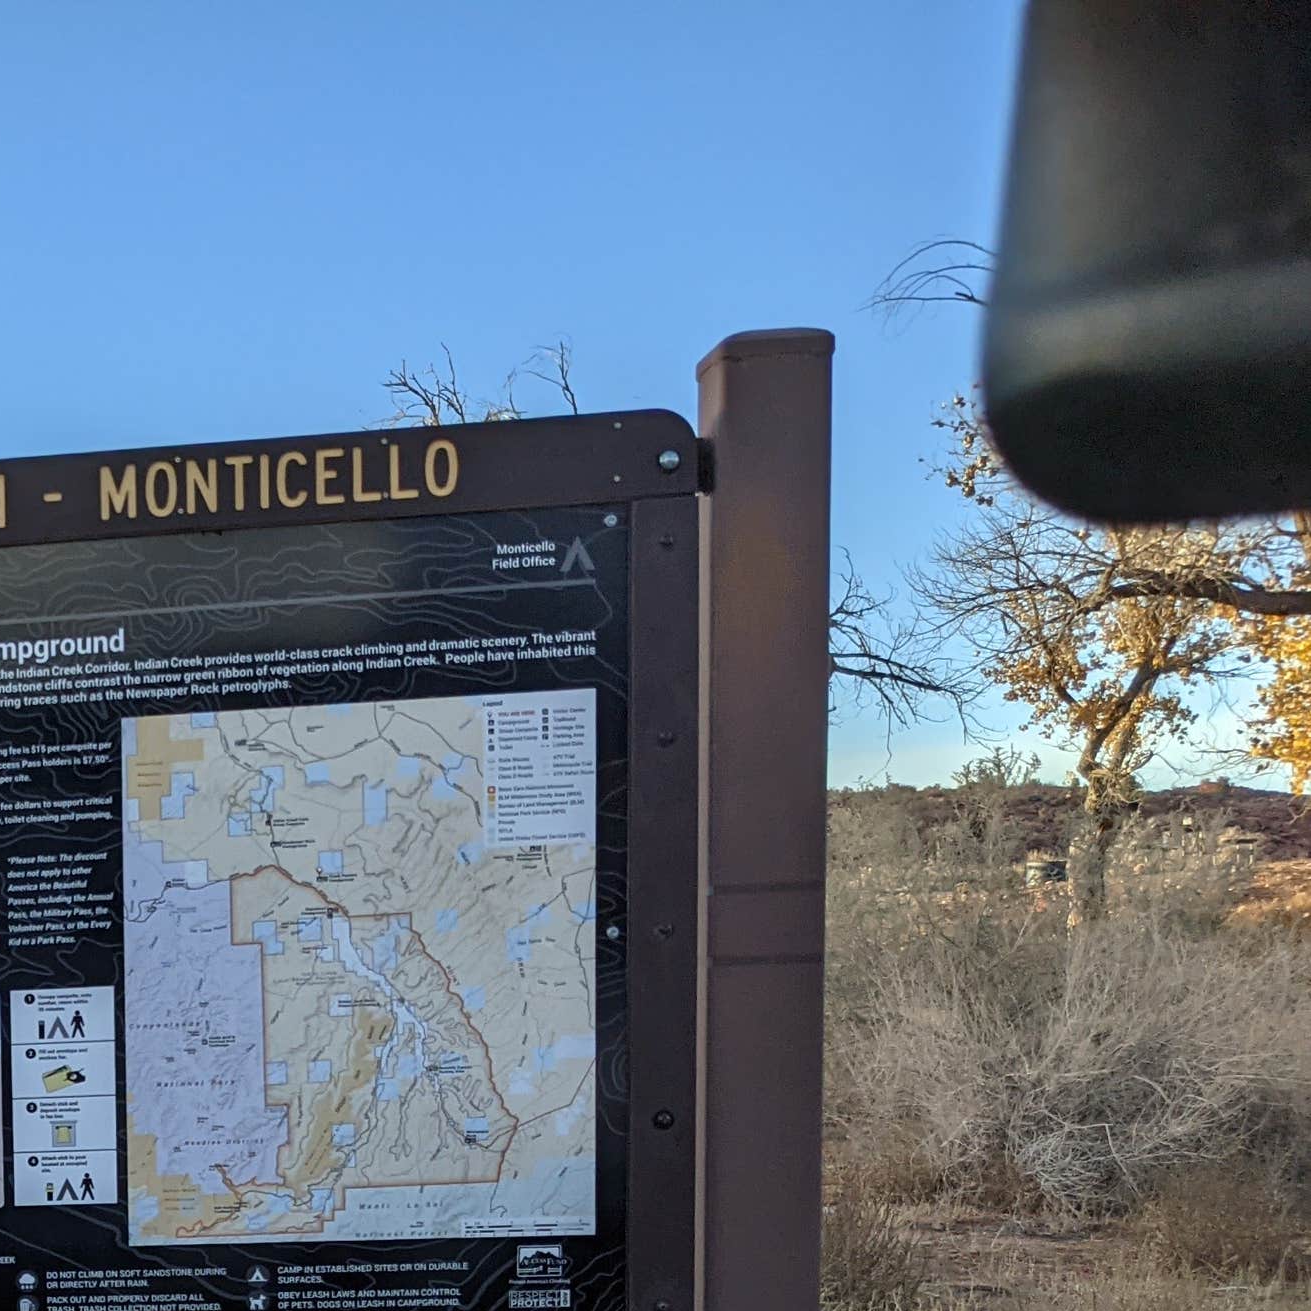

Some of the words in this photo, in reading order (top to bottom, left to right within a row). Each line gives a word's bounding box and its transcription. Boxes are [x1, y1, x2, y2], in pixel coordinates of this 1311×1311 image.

[100, 440, 460, 518] MONTICELLO
[496, 541, 555, 554] Monticello
[492, 558, 519, 570] Field
[522, 556, 555, 568] Office
[15, 666, 49, 679] Indian
[51, 663, 83, 677] Creek
[84, 661, 132, 674] Corridor.
[134, 659, 169, 671] Indian
[170, 656, 202, 669] Creek
[204, 653, 252, 670] provides
[254, 649, 319, 664] world-class
[321, 646, 352, 659] crack
[354, 644, 403, 657] climbing
[405, 641, 427, 654] and
[428, 638, 479, 652] dramatic
[481, 637, 529, 649] scenery.
[533, 633, 553, 646] The
[555, 630, 596, 644] vibrant
[44, 678, 72, 691] cliffs
[74, 675, 121, 689] contrast
[122, 674, 141, 686] the
[142, 673, 181, 684] narrow
[183, 671, 215, 685] green
[217, 667, 253, 680] ribbon
[255, 665, 267, 677] of
[270, 662, 329, 678] vegetation
[331, 661, 363, 674] along
[365, 658, 401, 670] Indian
[403, 655, 443, 668] Creek.
[445, 652, 485, 667] People
[487, 651, 514, 663] have
[517, 646, 571, 661] inhabited
[573, 645, 595, 658] this
[23, 694, 57, 706] traces
[60, 691, 87, 704] such
[89, 692, 103, 702] as
[105, 689, 123, 701] the
[125, 687, 187, 700] Newspaper
[190, 682, 219, 695] Rock
[221, 678, 293, 696] petroglyphs.
[45, 1271, 58, 1279] DO
[59, 1271, 76, 1279] NOT
[77, 1270, 104, 1279] CLIMB
[105, 1270, 118, 1278] ON
[119, 1270, 140, 1278] SOFT
[142, 1268, 193, 1277] SANDSTONE
[194, 1268, 227, 1276] DURING
[46, 1281, 58, 1289] OR
[59, 1280, 97, 1289] DIRECTLY
[99, 1280, 125, 1288] AFTER
[127, 1279, 151, 1288] RAIN.
[511, 1290, 560, 1299] RESPECT
[510, 1299, 559, 1307] PROTECT
